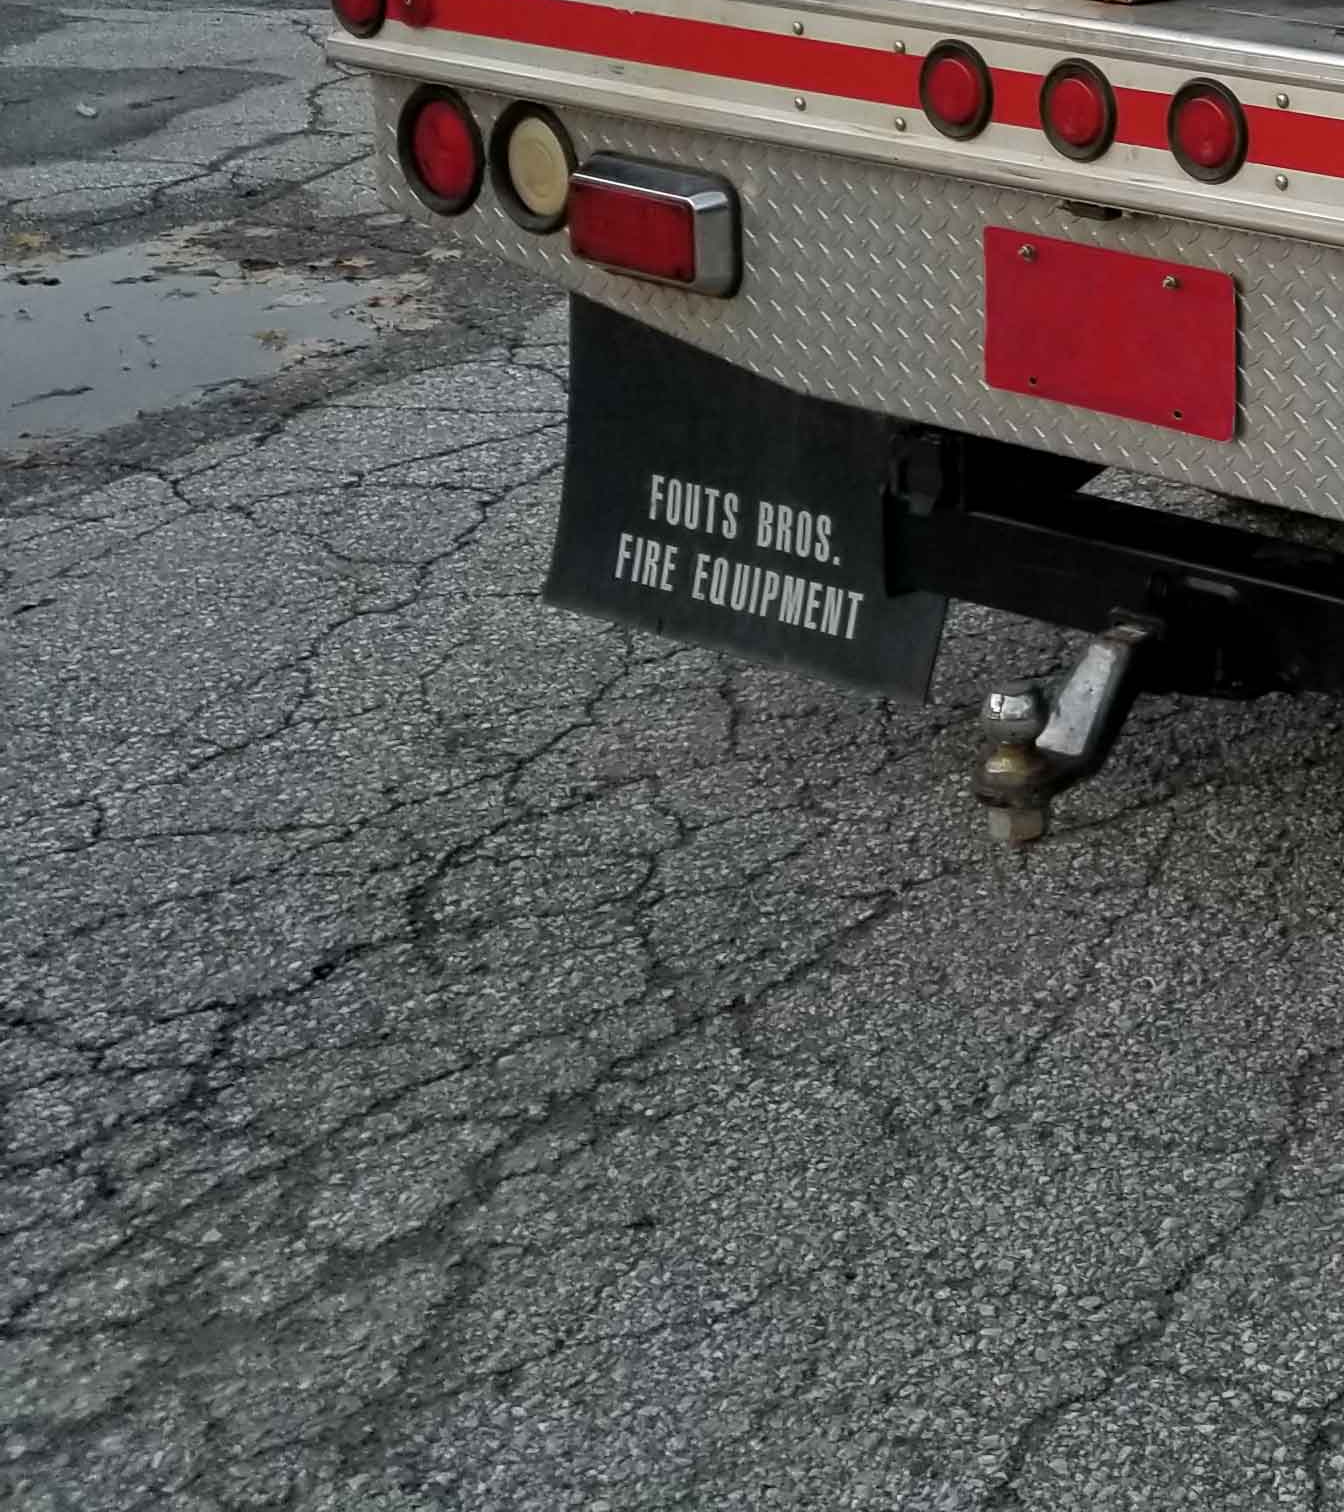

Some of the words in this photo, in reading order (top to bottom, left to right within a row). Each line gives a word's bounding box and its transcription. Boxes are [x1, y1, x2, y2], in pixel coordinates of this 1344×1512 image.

[648, 474, 739, 540] FOUTS
[756, 500, 841, 566] BROS.
[615, 532, 679, 592] FIRE
[690, 552, 865, 640] EQUIPMENT
